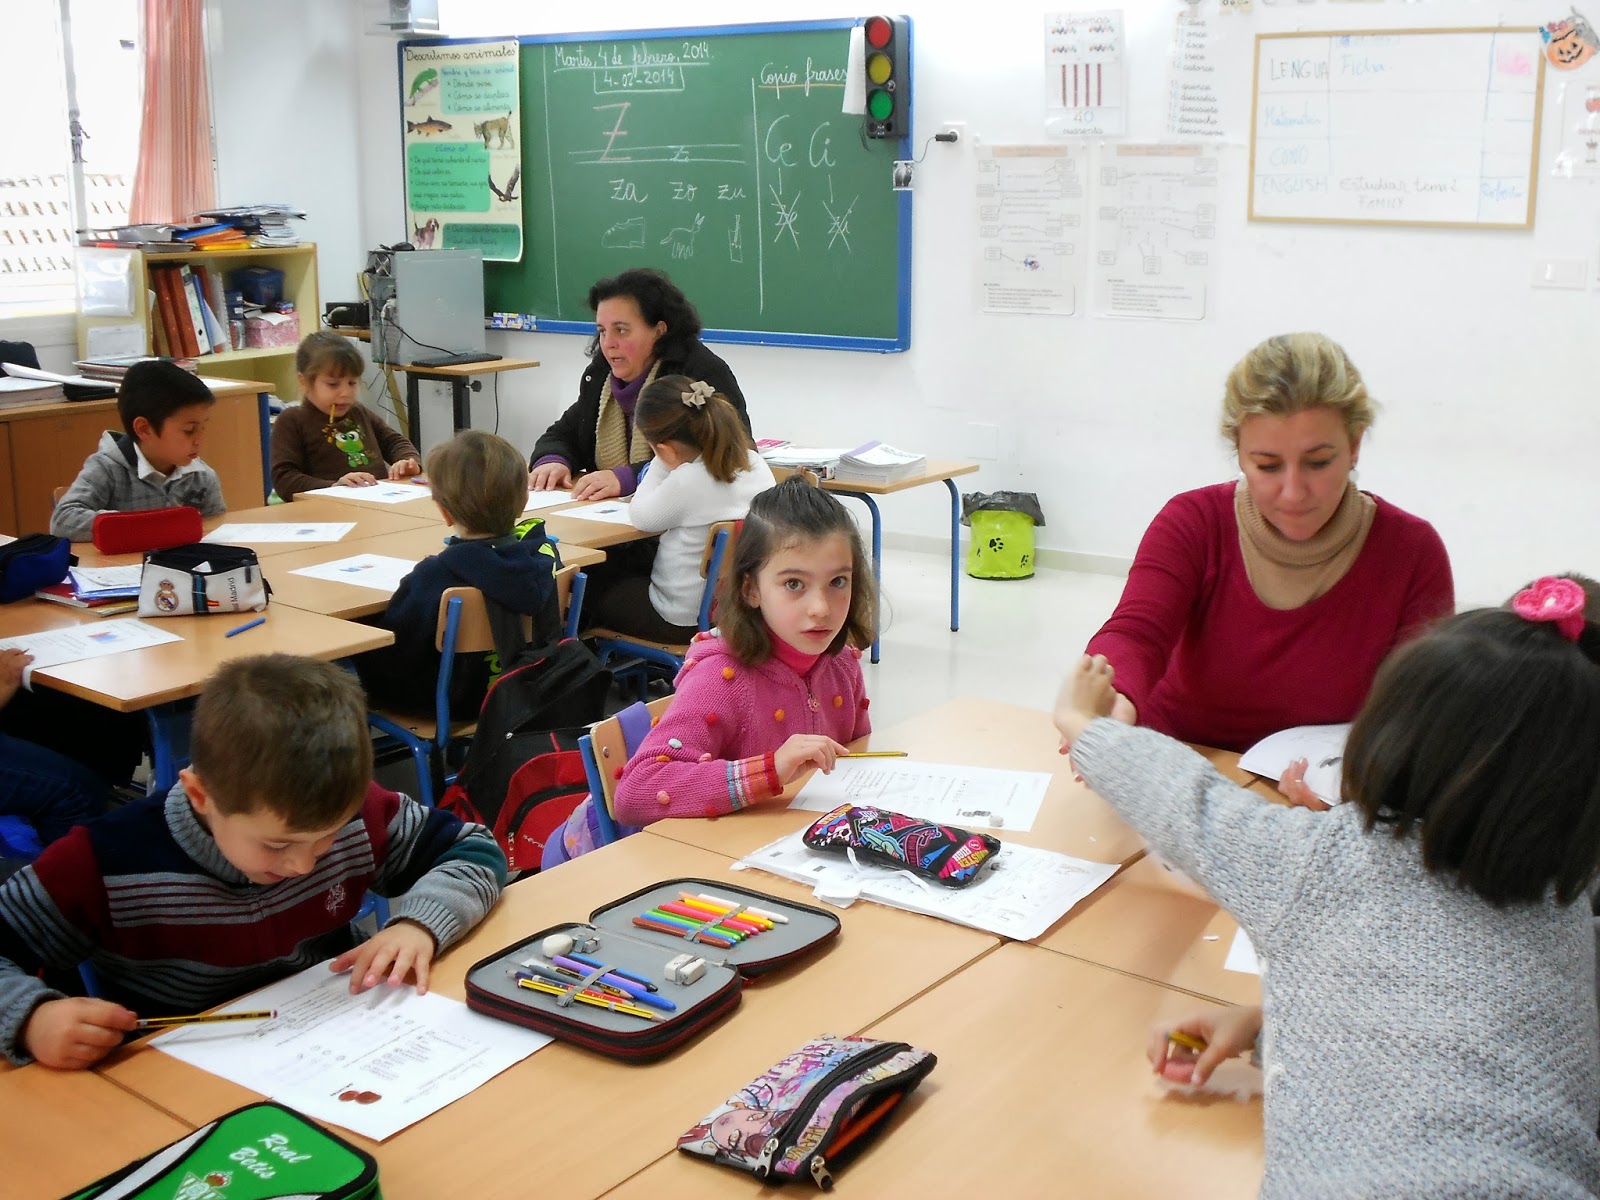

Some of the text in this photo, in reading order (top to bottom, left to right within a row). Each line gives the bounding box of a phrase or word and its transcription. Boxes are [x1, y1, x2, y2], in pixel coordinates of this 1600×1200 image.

[463, 45, 516, 60] animales
[598, 45, 608, 66] 4
[612, 44, 623, 66] de
[760, 62, 797, 99] Copio
[1270, 58, 1329, 81] LENGUA
[1073, 110, 1094, 123] 40
[1062, 127, 1104, 136] cuarenta
[1261, 176, 1328, 194] ENGLISH
[257, 1132, 313, 1164] Real
[229, 1147, 276, 1179] Betis
